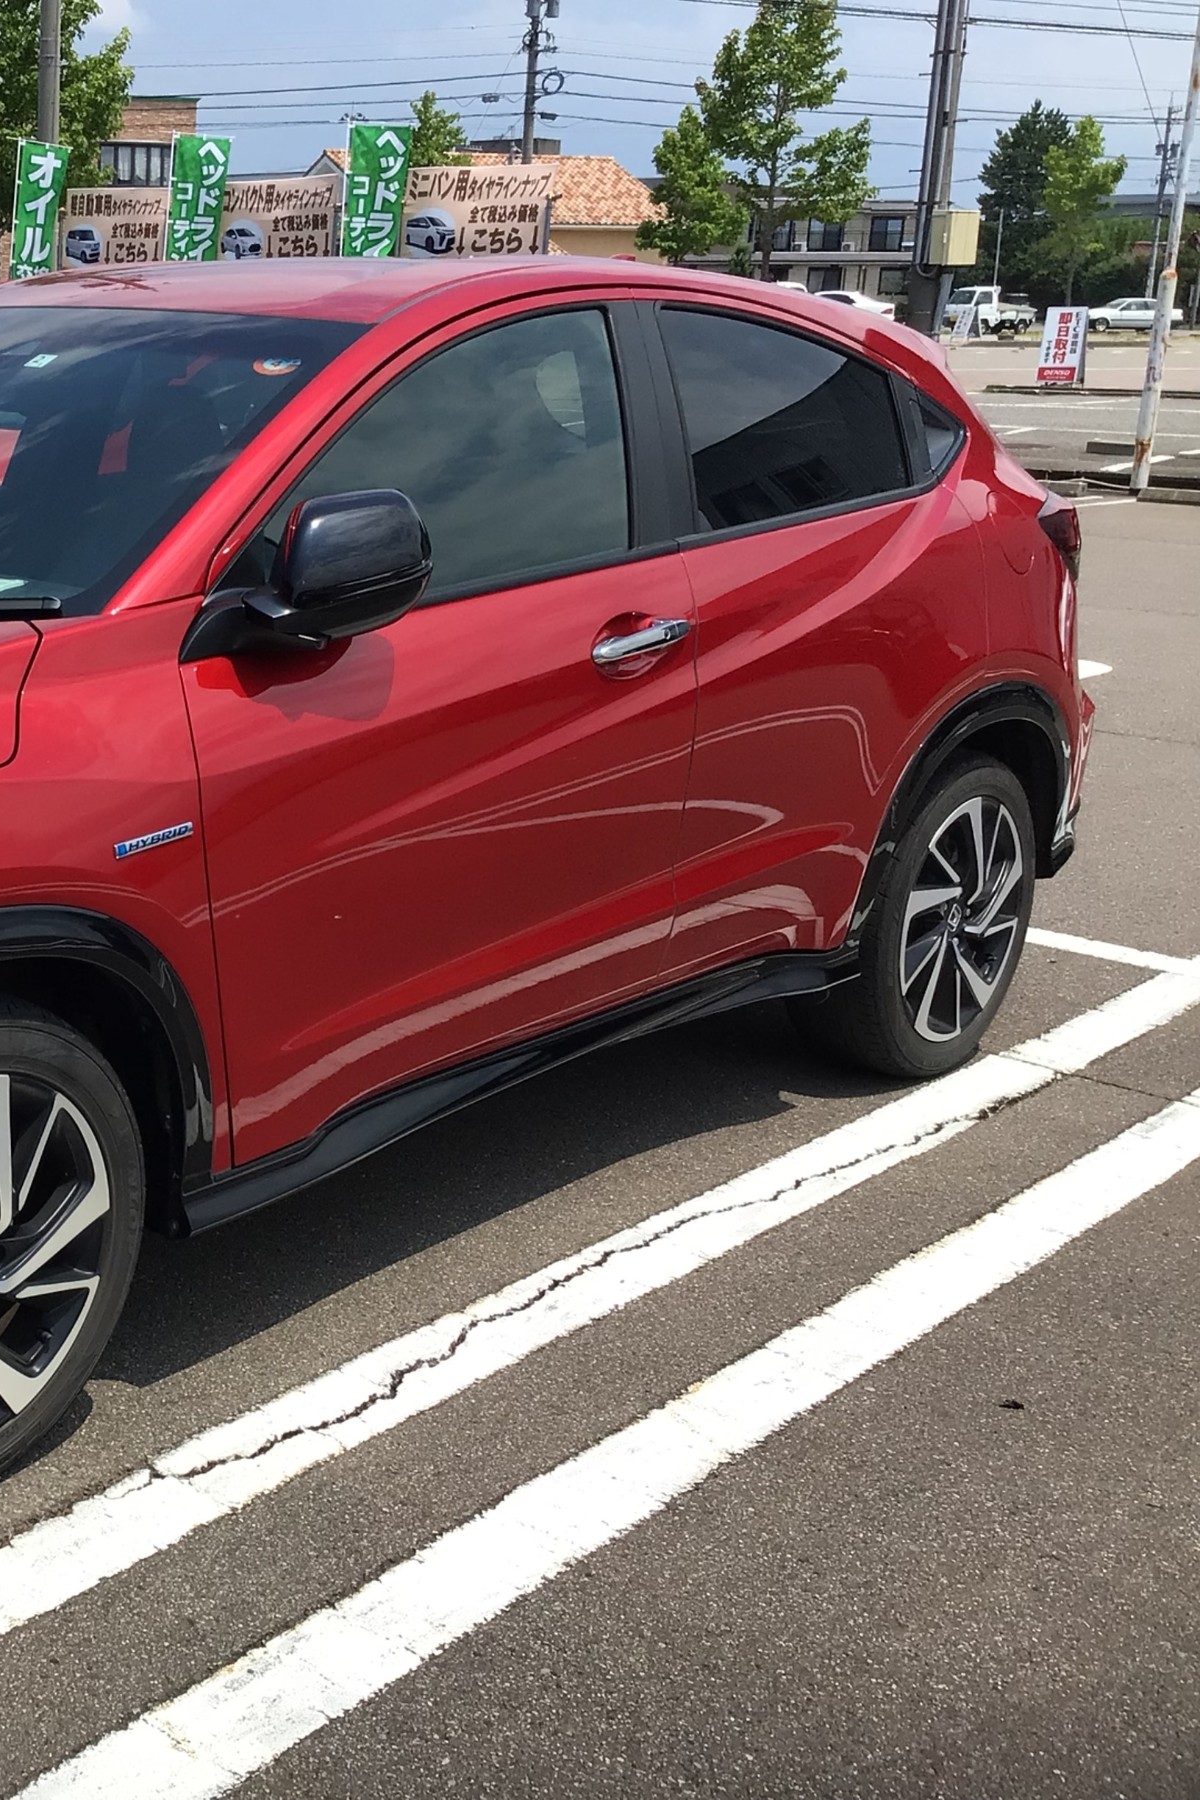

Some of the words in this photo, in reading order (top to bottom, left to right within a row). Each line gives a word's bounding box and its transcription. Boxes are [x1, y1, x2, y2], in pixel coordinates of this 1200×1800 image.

[409, 169, 552, 202] ミニバン用タイヤラインナップ
[20, 151, 62, 262] オイル
[468, 203, 539, 224] 全て税込み価格
[111, 223, 159, 239] 全て税込み価格
[272, 214, 328, 232] 全て税込み価格
[278, 234, 318, 257] こちら
[470, 227, 523, 253] こちら
[114, 242, 148, 263] こちら
[1052, 312, 1073, 364] 即日取付
[128, 825, 189, 852] HYBRID
